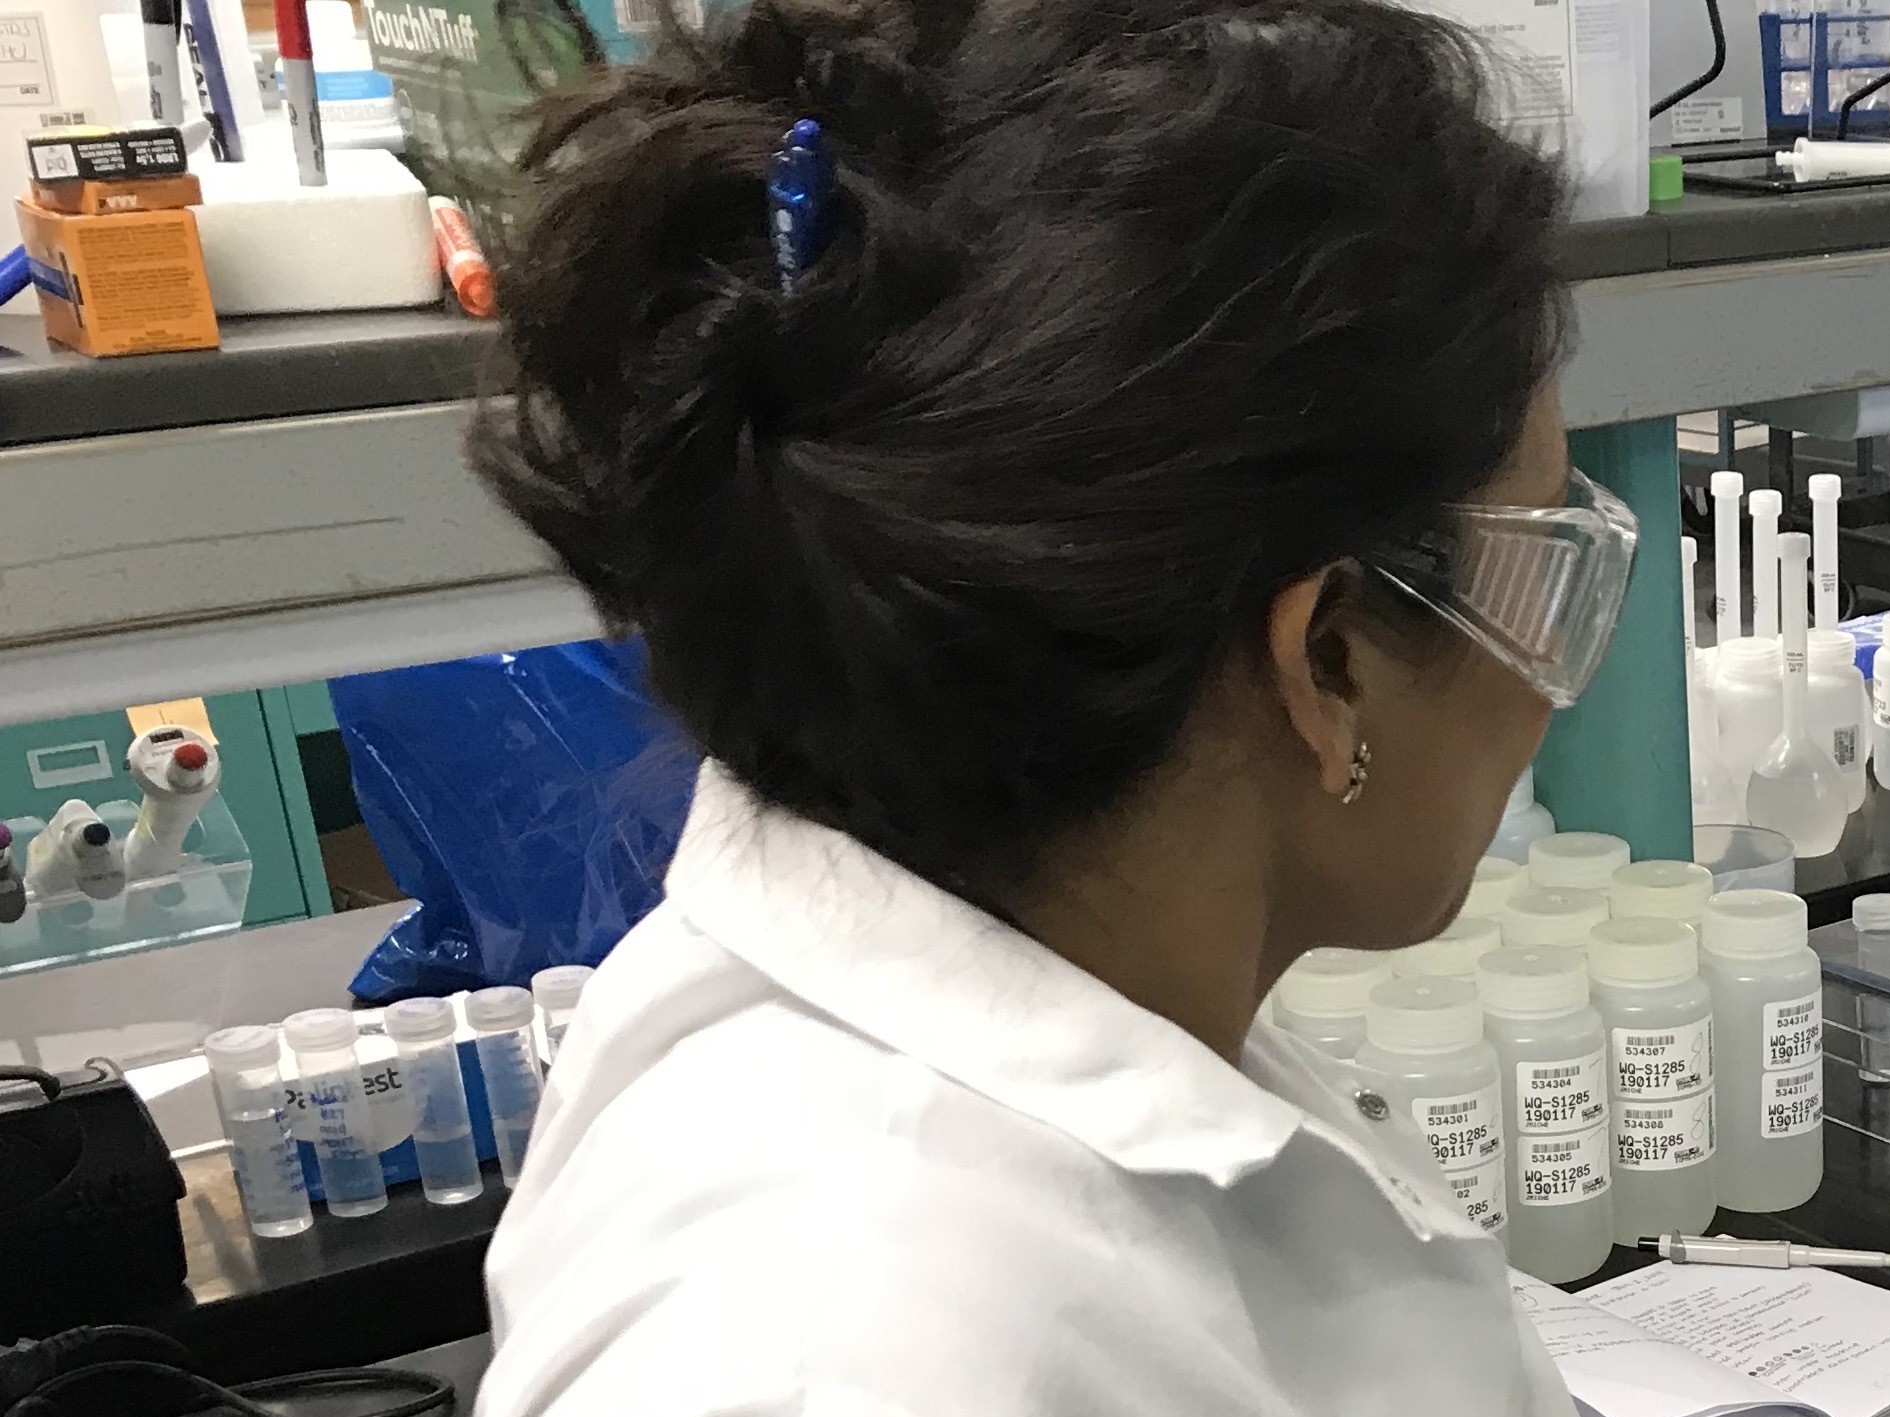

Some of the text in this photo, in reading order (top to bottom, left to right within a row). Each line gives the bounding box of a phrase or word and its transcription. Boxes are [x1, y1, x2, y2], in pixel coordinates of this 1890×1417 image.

[363, 0, 478, 64] TouchNTuff
[1777, 1014, 1809, 1028] 534310
[1625, 1047, 1666, 1056] 534307
[1770, 1041, 1811, 1060] 190117
[1619, 1060, 1685, 1075] WQ-S1285
[1532, 1079, 1571, 1090] 534304
[1620, 1075, 1670, 1088] 190117
[1775, 1084, 1807, 1097] 534311
[1524, 1090, 1590, 1109] WQ-S1285
[1428, 1114, 1469, 1126] 534301
[1525, 1106, 1576, 1121] 190117
[1769, 1110, 1810, 1127] 190117
[1624, 1120, 1664, 1130] 534308
[1428, 1124, 1487, 1146] Q-S1285
[1617, 1133, 1684, 1148] WQ-S1285
[1532, 1152, 1572, 1163] 534305
[1619, 1147, 1668, 1160] 190117
[1525, 1163, 1591, 1182] WQ-S1285
[1526, 1180, 1576, 1195] 190117
